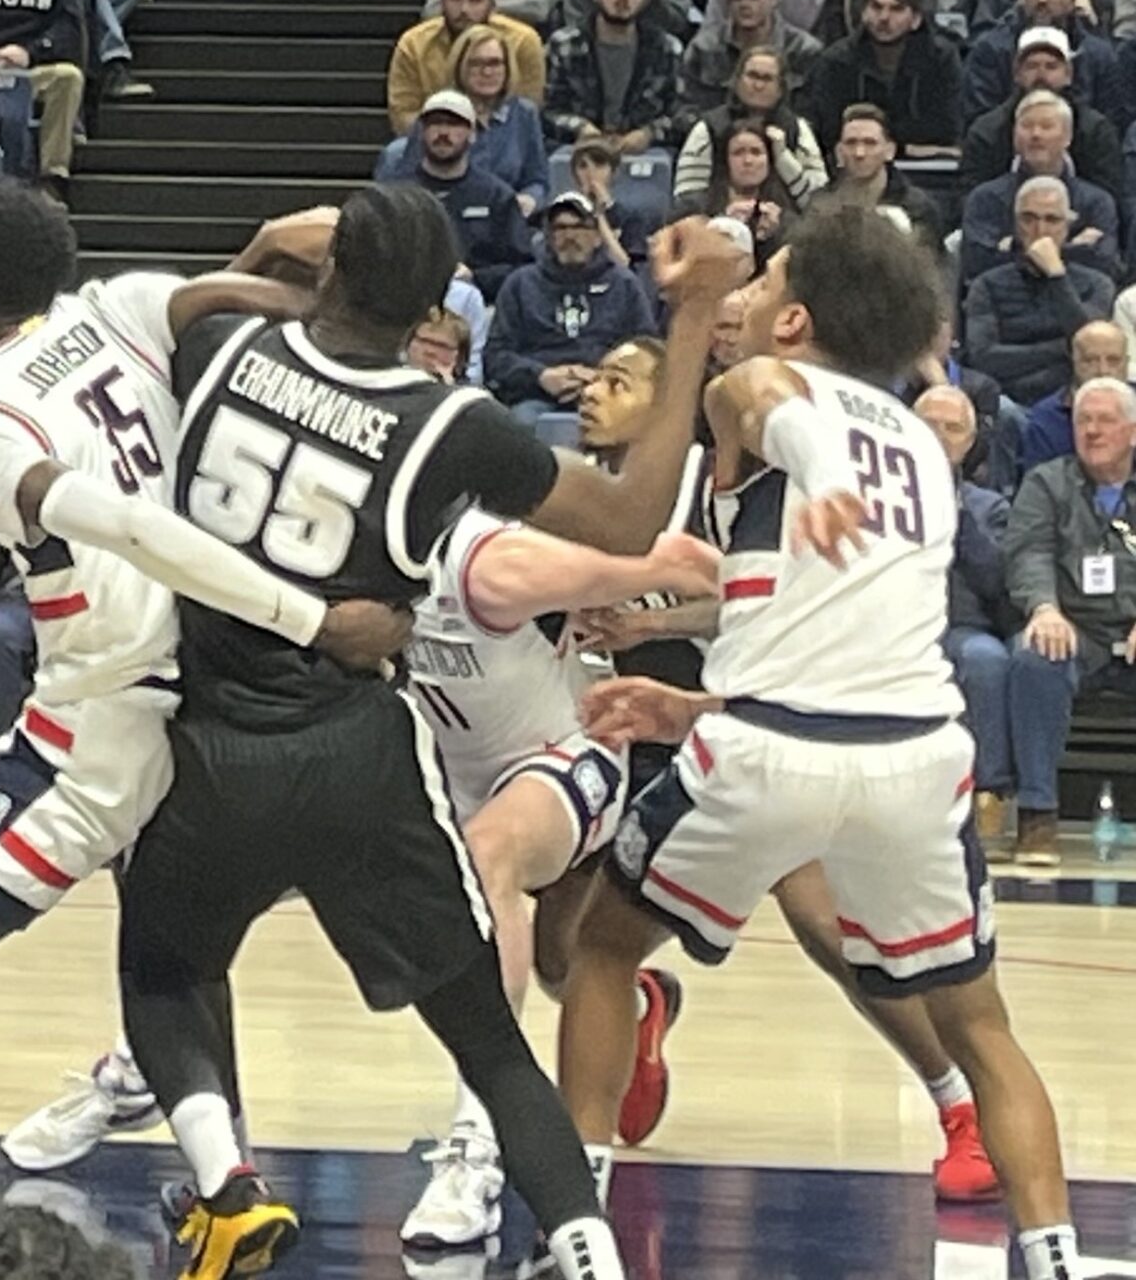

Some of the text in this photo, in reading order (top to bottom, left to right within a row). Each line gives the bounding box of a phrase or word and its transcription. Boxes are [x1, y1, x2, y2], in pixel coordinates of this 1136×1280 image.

[73, 364, 164, 495] 35
[189, 404, 373, 578] 55
[849, 428, 925, 545] 23
